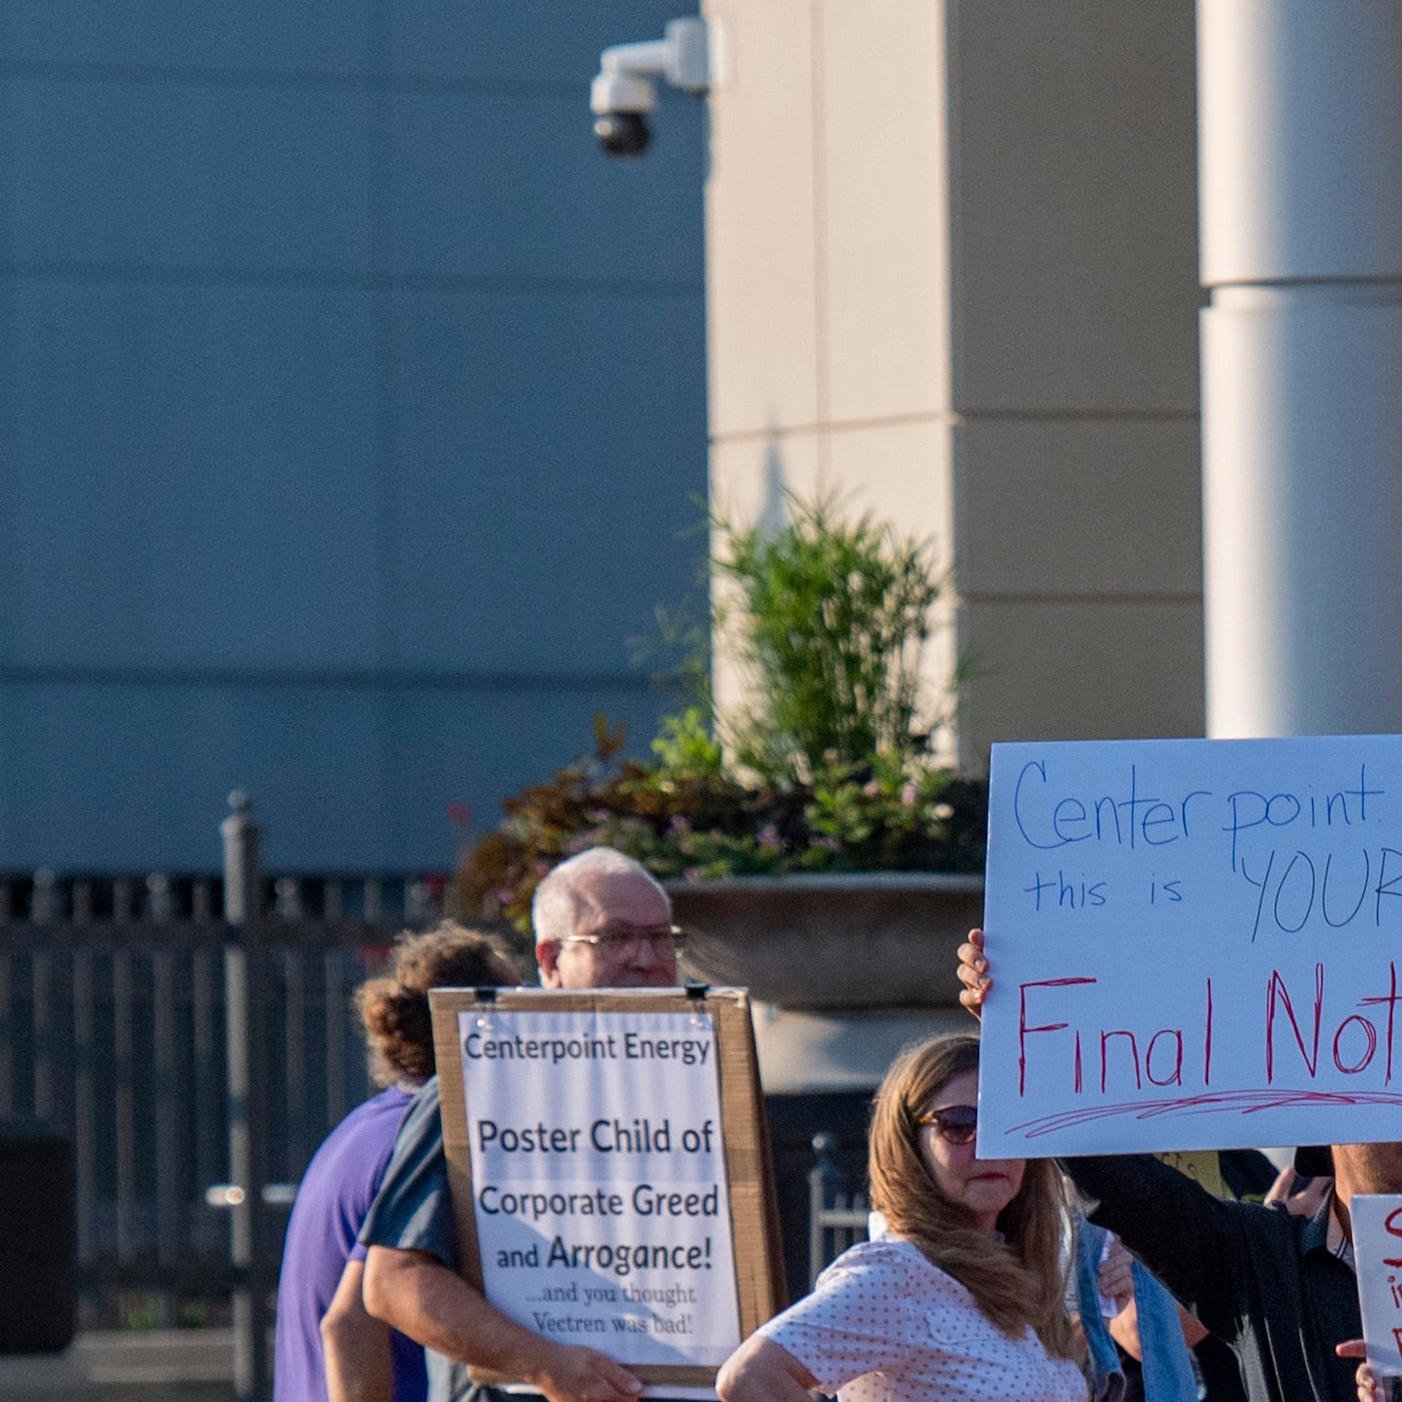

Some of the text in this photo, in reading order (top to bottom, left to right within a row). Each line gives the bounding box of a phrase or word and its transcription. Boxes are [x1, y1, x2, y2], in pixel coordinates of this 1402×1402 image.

[1025, 871, 1107, 911] this
[1152, 875, 1182, 904] is
[465, 1033, 710, 1064] Centerpoint Energy
[1020, 976, 1211, 1096] Final
[478, 1119, 714, 1153] Poster Child of
[480, 1184, 719, 1220] Corporate Greed
[497, 1237, 712, 1275] and Arrogance!
[585, 1288, 617, 1305] you
[623, 1283, 696, 1305] thought
[532, 1312, 692, 1335] Vectren was bad!
